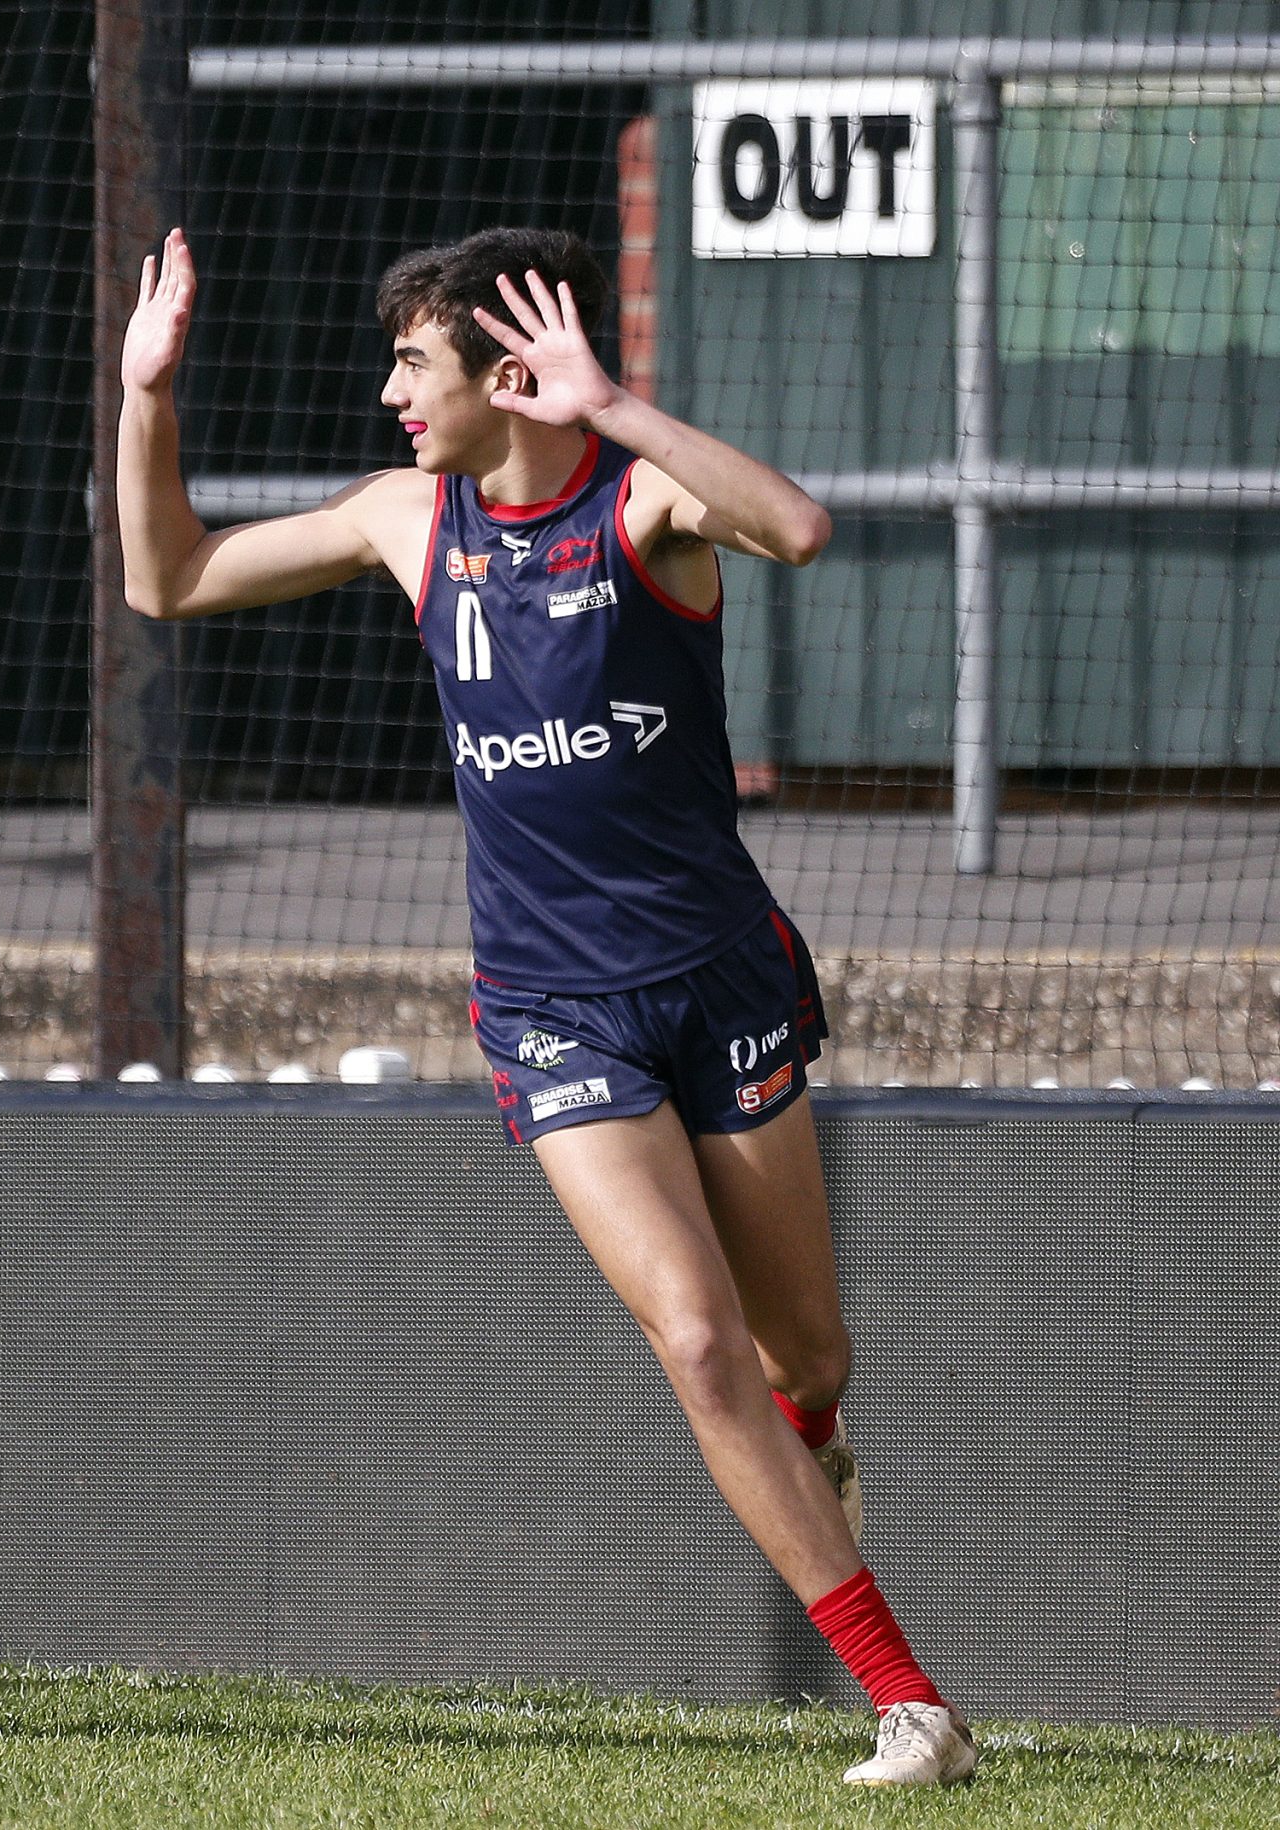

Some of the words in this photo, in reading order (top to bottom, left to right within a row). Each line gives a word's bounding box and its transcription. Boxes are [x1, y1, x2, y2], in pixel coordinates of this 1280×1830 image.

[721, 113, 911, 221] OUT
[549, 586, 598, 606] PARADISE
[455, 718, 611, 782] Apelle
[530, 1082, 585, 1107] PARADISE
[558, 1093, 606, 1109] MAZDA
